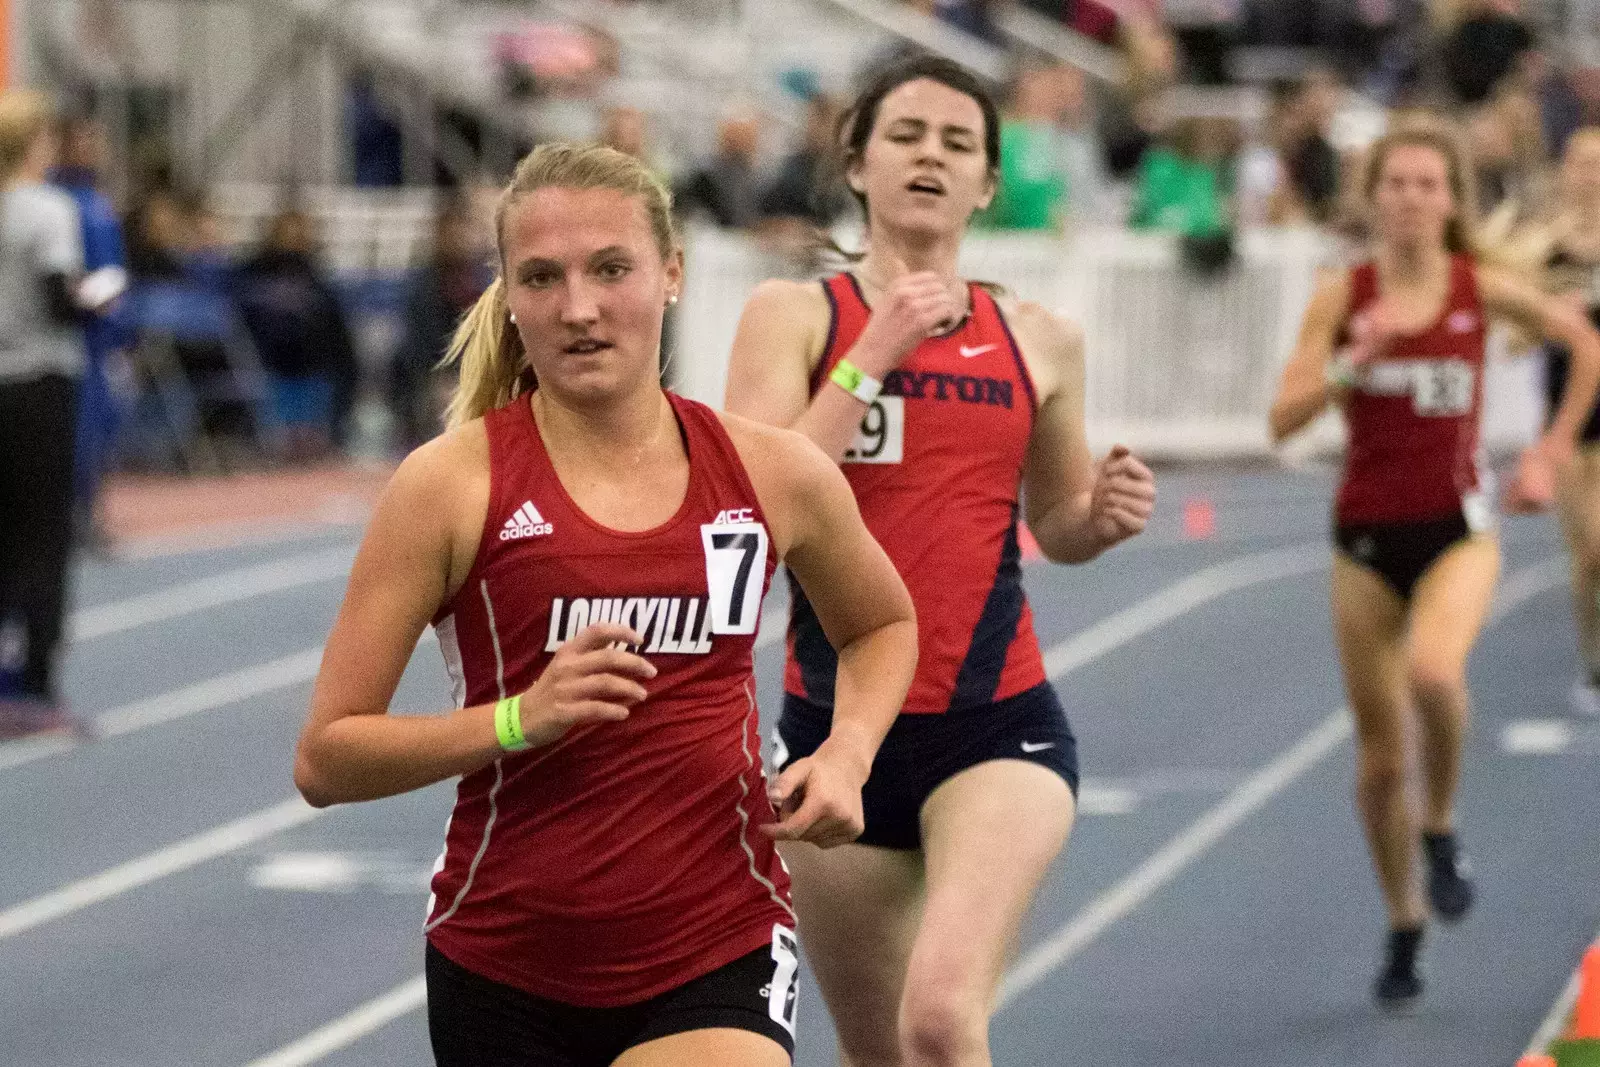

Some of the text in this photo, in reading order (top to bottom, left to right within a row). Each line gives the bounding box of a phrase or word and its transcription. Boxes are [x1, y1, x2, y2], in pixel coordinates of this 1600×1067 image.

[878, 370, 1014, 409] AYTON
[845, 400, 888, 458] 9
[499, 522, 554, 541] adidas
[713, 508, 754, 525] ACC
[711, 532, 759, 627] 7
